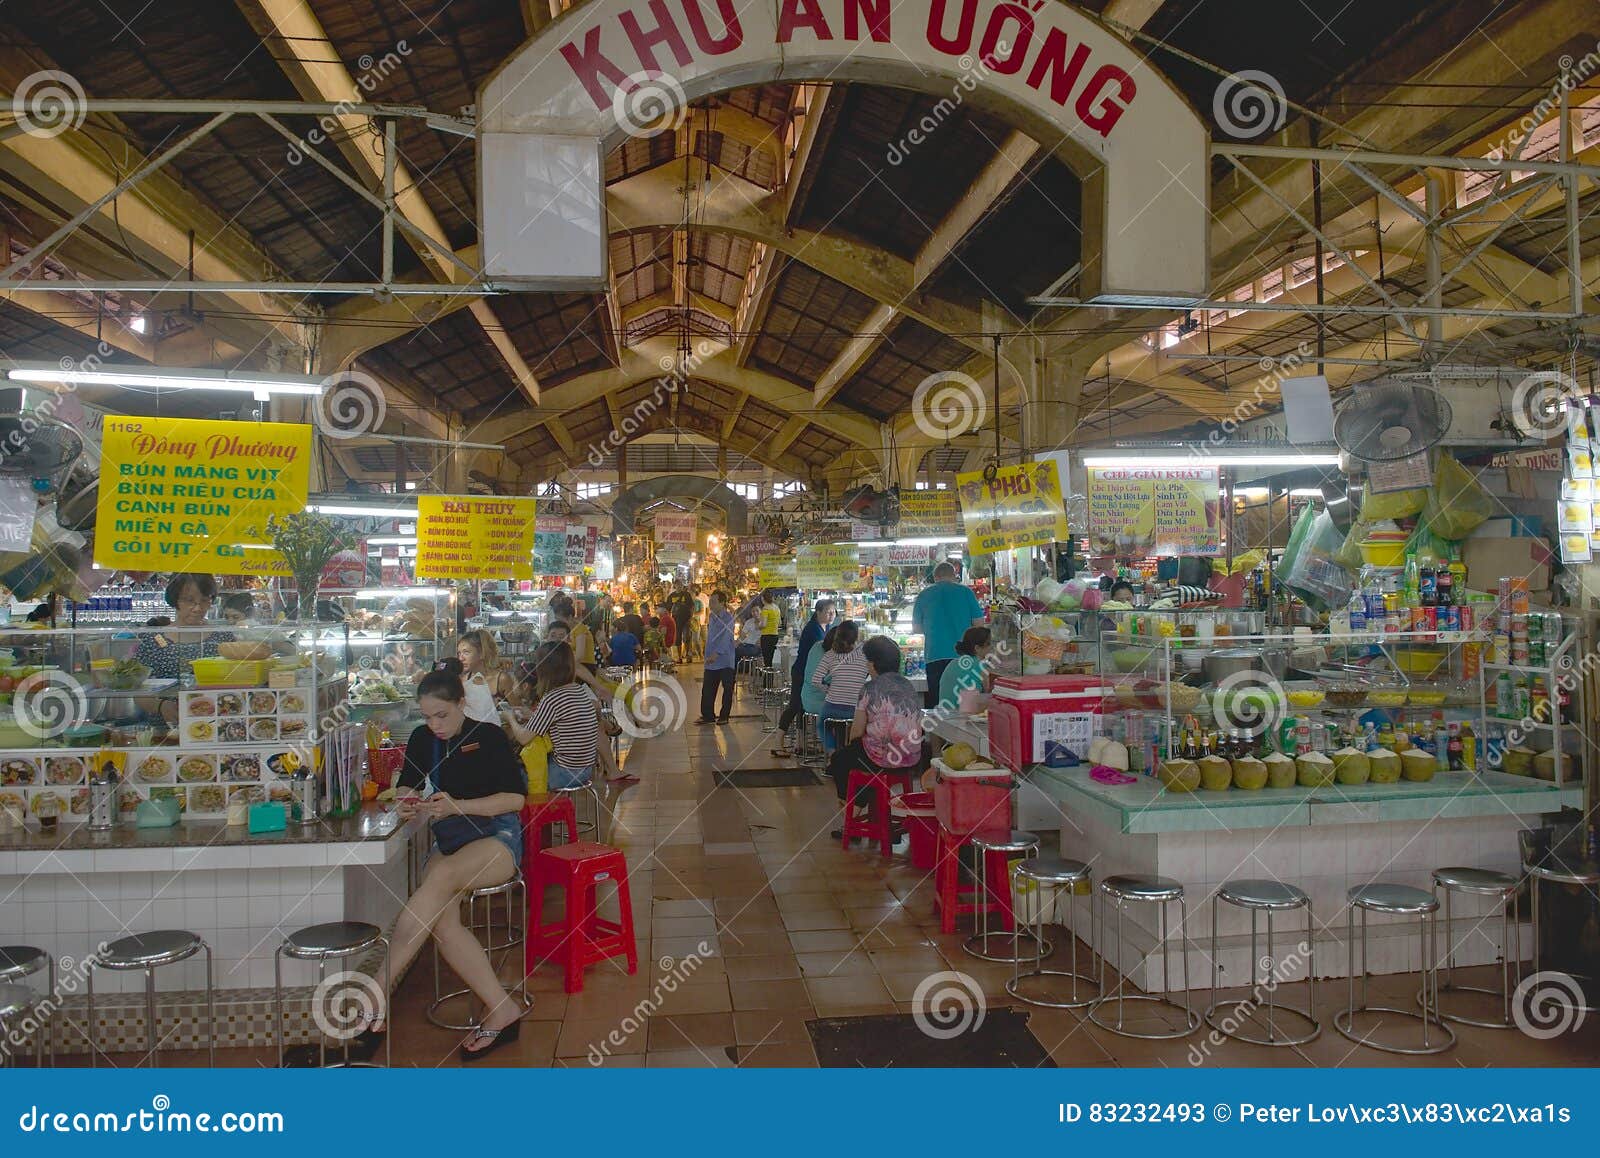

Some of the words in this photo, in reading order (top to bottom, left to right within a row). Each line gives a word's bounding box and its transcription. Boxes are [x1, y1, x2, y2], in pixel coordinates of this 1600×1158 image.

[559, 0, 743, 111] KHU
[110, 423, 143, 433] 1162
[131, 434, 197, 460] Đông
[205, 434, 298, 463] Phương
[119, 461, 166, 477] BÚN
[246, 467, 281, 484] VỊT
[118, 479, 163, 495] BÚN
[172, 482, 225, 499] RIÊU
[233, 486, 276, 501] CUA
[116, 500, 175, 514] CANH
[184, 500, 231, 516] BÚN
[113, 536, 150, 554] GỎI
[159, 542, 193, 558] VỊT
